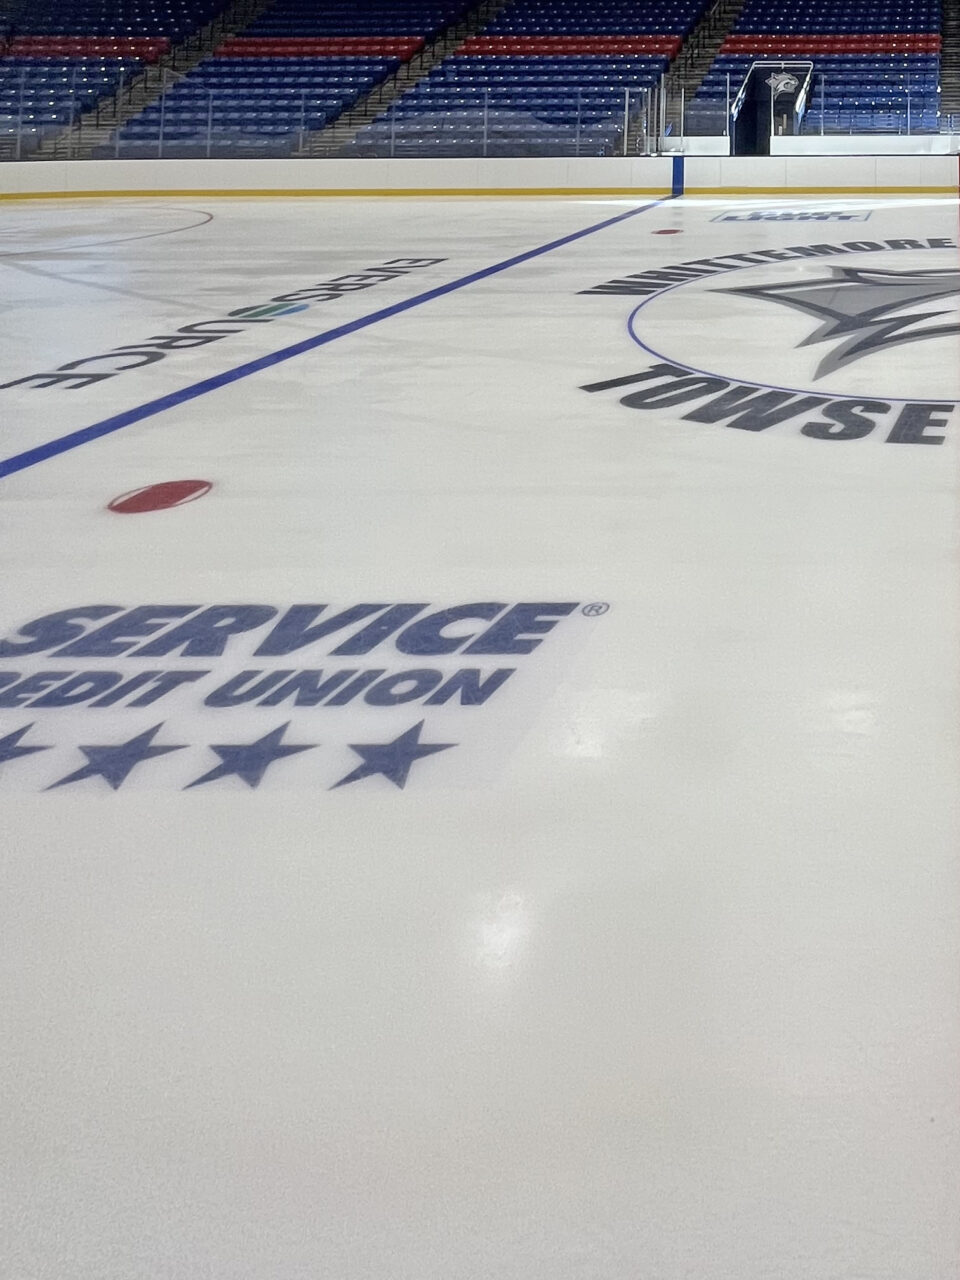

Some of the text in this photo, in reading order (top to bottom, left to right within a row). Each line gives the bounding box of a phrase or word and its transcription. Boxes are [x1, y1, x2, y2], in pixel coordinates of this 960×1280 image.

[575, 237, 957, 295] WHITTEMORE
[577, 363, 955, 445] TOWSE
[204, 669, 517, 708] UNION
